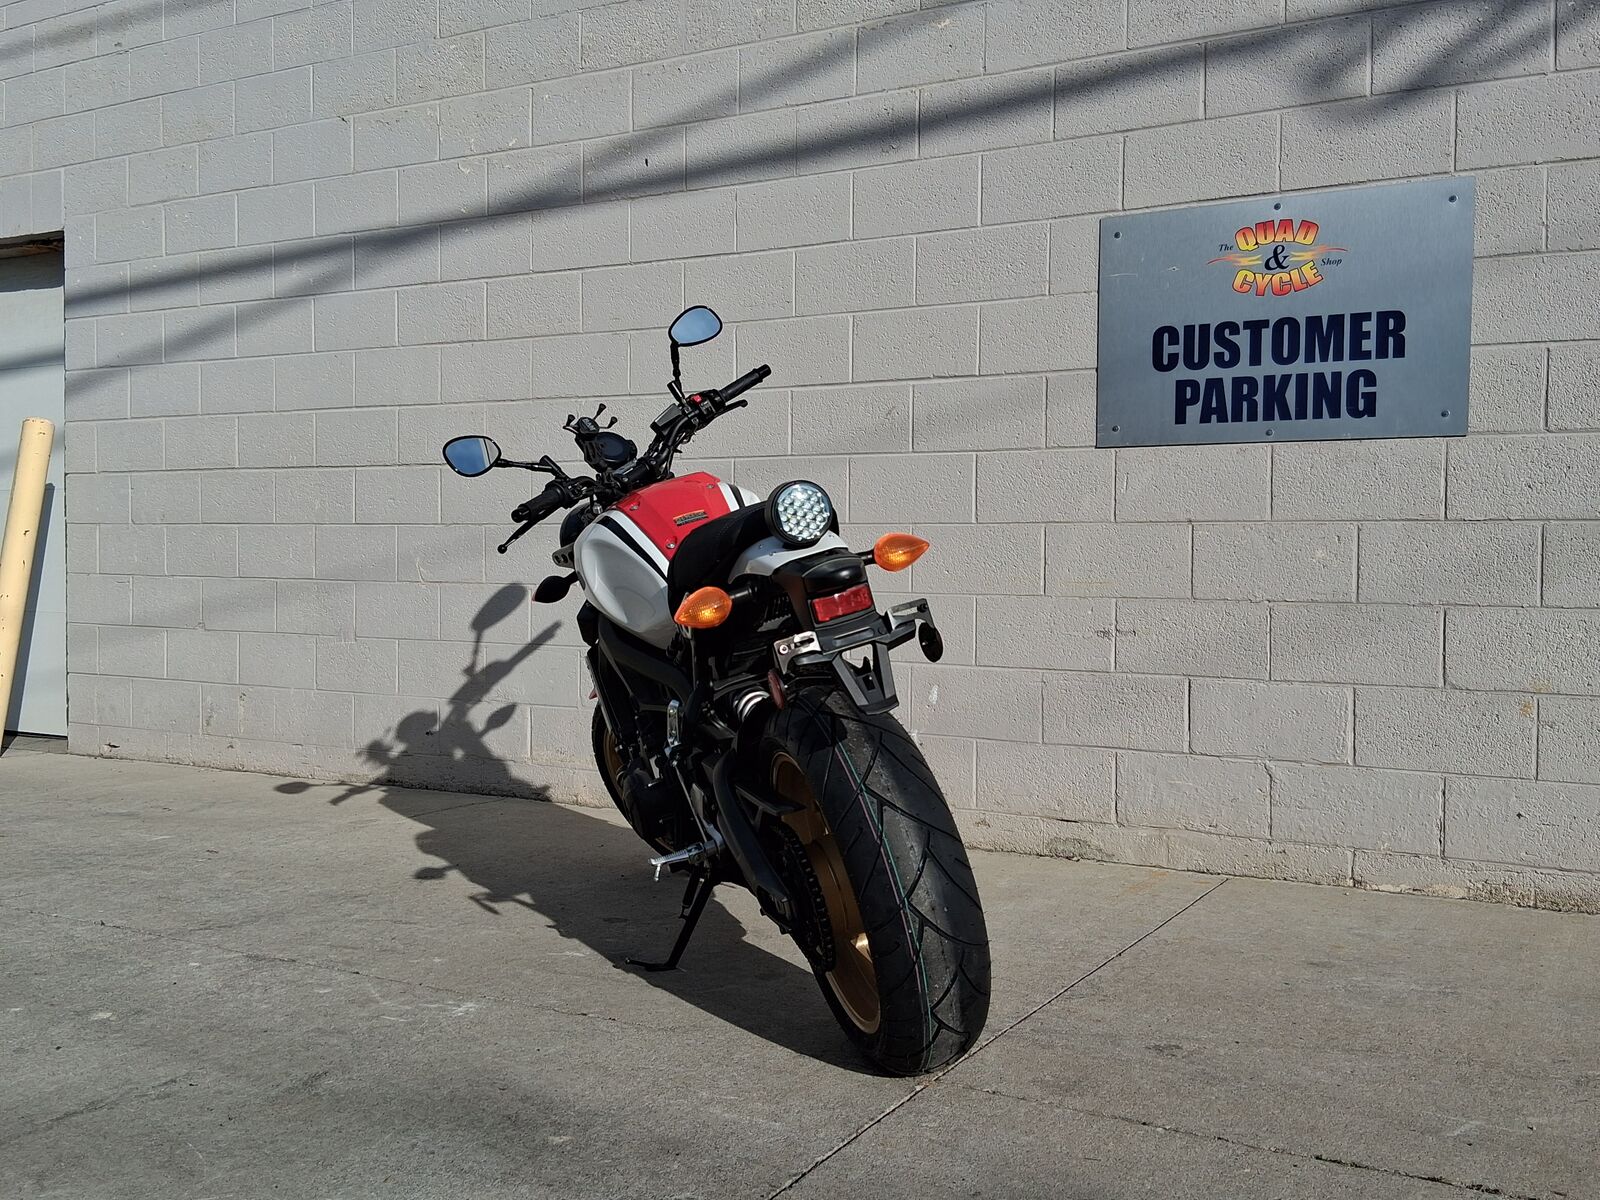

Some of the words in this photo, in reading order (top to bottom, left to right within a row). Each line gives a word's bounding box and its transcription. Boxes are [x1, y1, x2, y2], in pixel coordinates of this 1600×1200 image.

[1218, 244, 1234, 252] The
[1235, 219, 1319, 251] QUAD
[1264, 245, 1290, 271] &
[1320, 258, 1343, 266] Shop
[1232, 260, 1323, 296] CYCLE
[1151, 310, 1406, 372] CUSTOMER
[1174, 369, 1377, 424] PARKING
